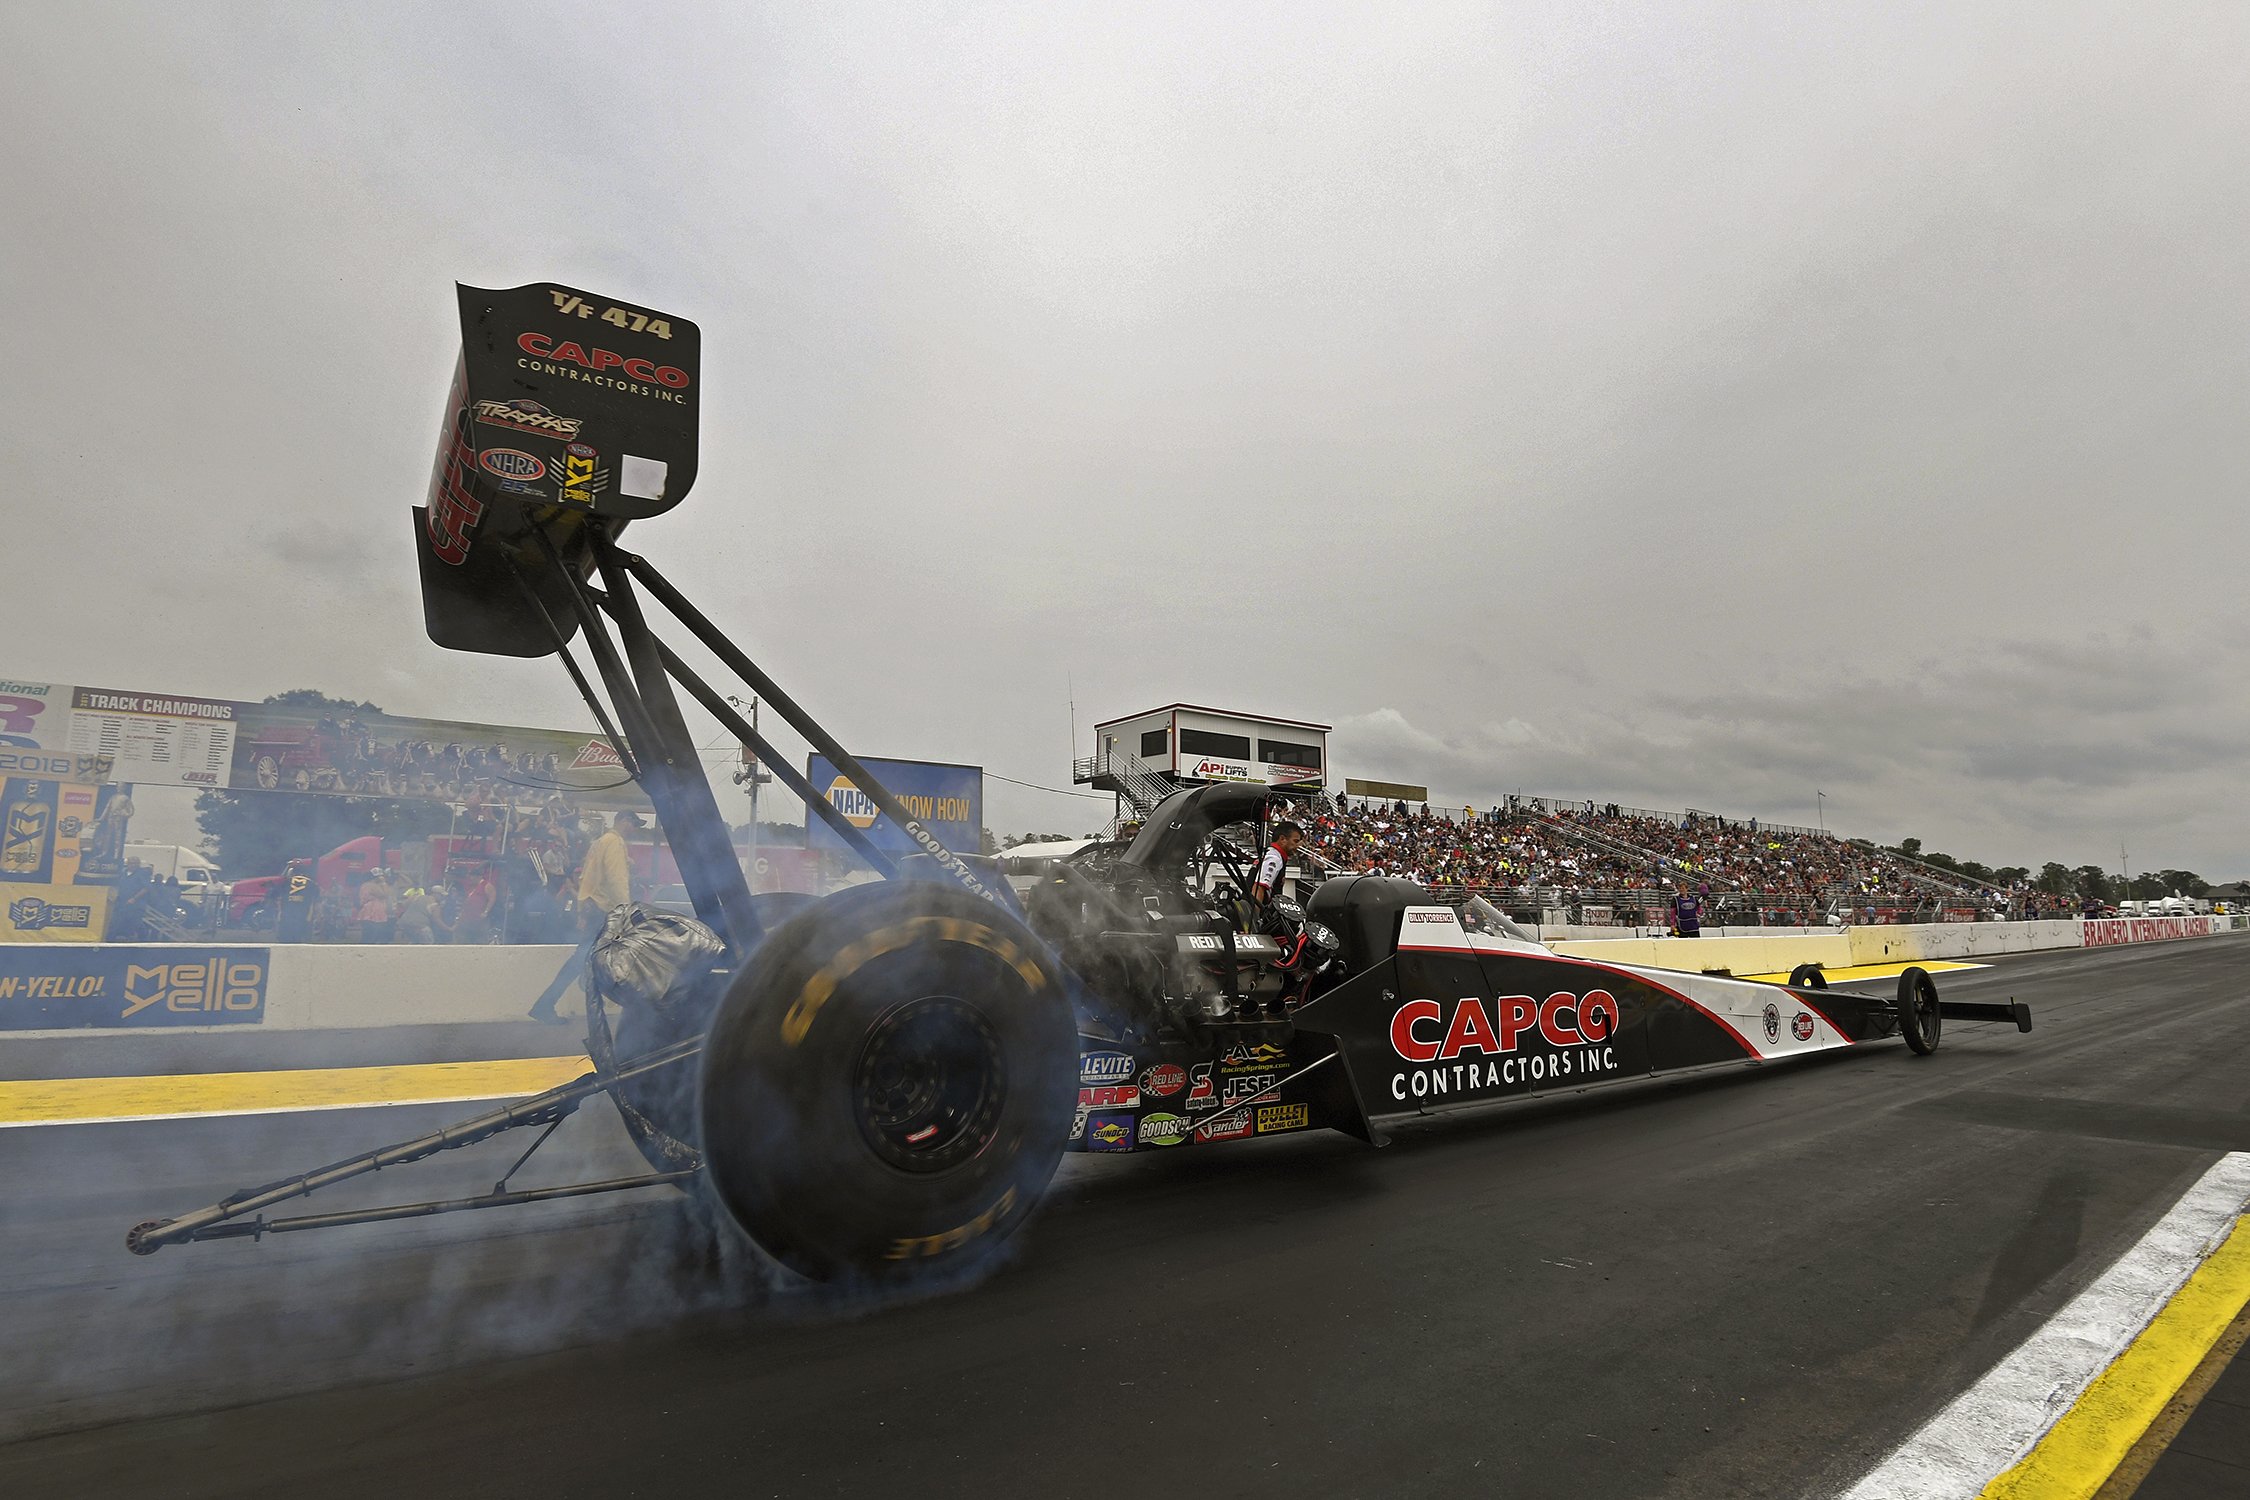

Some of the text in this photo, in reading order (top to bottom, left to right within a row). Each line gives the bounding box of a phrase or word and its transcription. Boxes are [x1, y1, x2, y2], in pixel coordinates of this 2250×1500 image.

[549, 289, 672, 340] T/F 474
[517, 332, 690, 389] CAPCO
[517, 358, 687, 405] CONTRACTORS INC.
[479, 403, 577, 434] TRAXXAS
[491, 454, 535, 474] NHRA
[90, 694, 138, 711] TRACK
[143, 699, 232, 719] CHAMPIONS
[0, 754, 71, 774] 2018
[833, 789, 875, 816] NAPA
[894, 795, 970, 822] NOW HOW
[1279, 903, 1301, 912] MSD
[1409, 914, 1454, 923] BILLY TORRENCE
[1317, 928, 1329, 943] MSD
[2084, 920, 2128, 947] BRAINERD
[2130, 918, 2184, 942] INTERNATIONAL
[2185, 917, 2209, 936] RACEWAY
[1189, 936, 1264, 949] RED LE OIL
[1390, 989, 1619, 1062] CAPCO
[1080, 1055, 1134, 1075] LEVITE
[1221, 1063, 1290, 1074] RacingSprings.com
[1392, 1047, 1618, 1100] CONTRACTORS INC.
[1152, 1073, 1183, 1085] RED LINE
[1078, 1087, 1138, 1105] ARP
[1260, 1104, 1306, 1123] BULLET
[1094, 1128, 1129, 1138] SUNOCO
[1264, 1119, 1304, 1130] RACING CAMS
